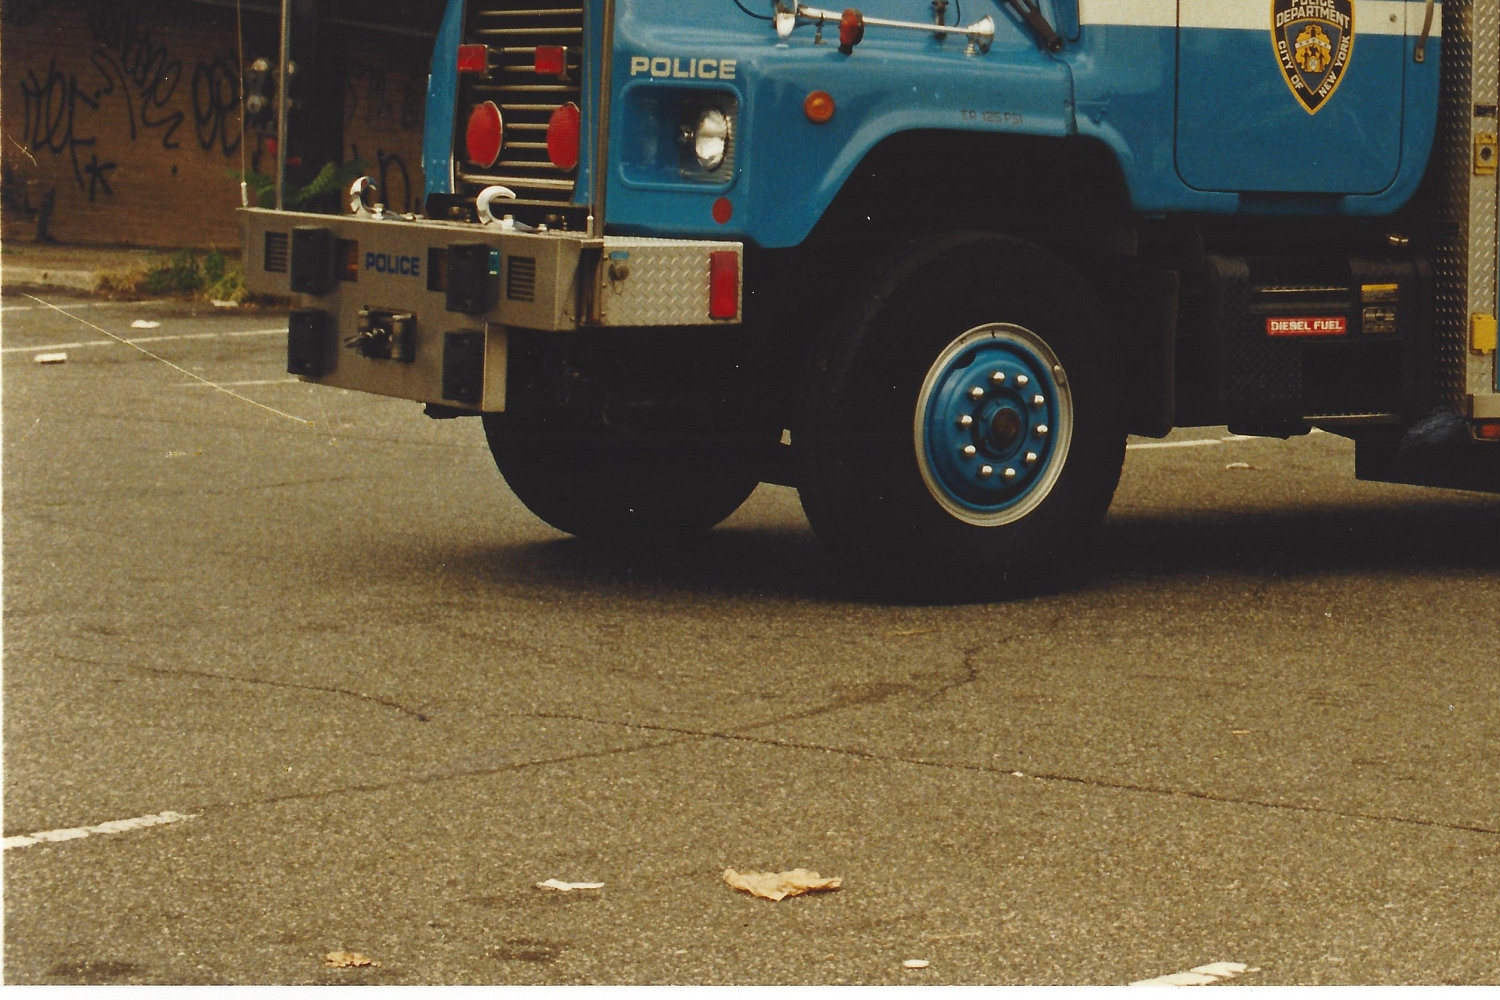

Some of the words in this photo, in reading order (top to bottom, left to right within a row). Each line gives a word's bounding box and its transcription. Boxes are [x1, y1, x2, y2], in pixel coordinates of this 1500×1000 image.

[1276, 5, 1351, 29] DEPARTMENT
[630, 56, 738, 80] POLICE
[1277, 40, 1294, 70] CITY
[1290, 74, 1305, 90] OF
[1318, 70, 1338, 98] NEW
[1334, 35, 1351, 68] YORK
[365, 252, 420, 277] POLICE
[1270, 320, 1312, 331] DIESEL
[1313, 320, 1343, 330] FUEL
